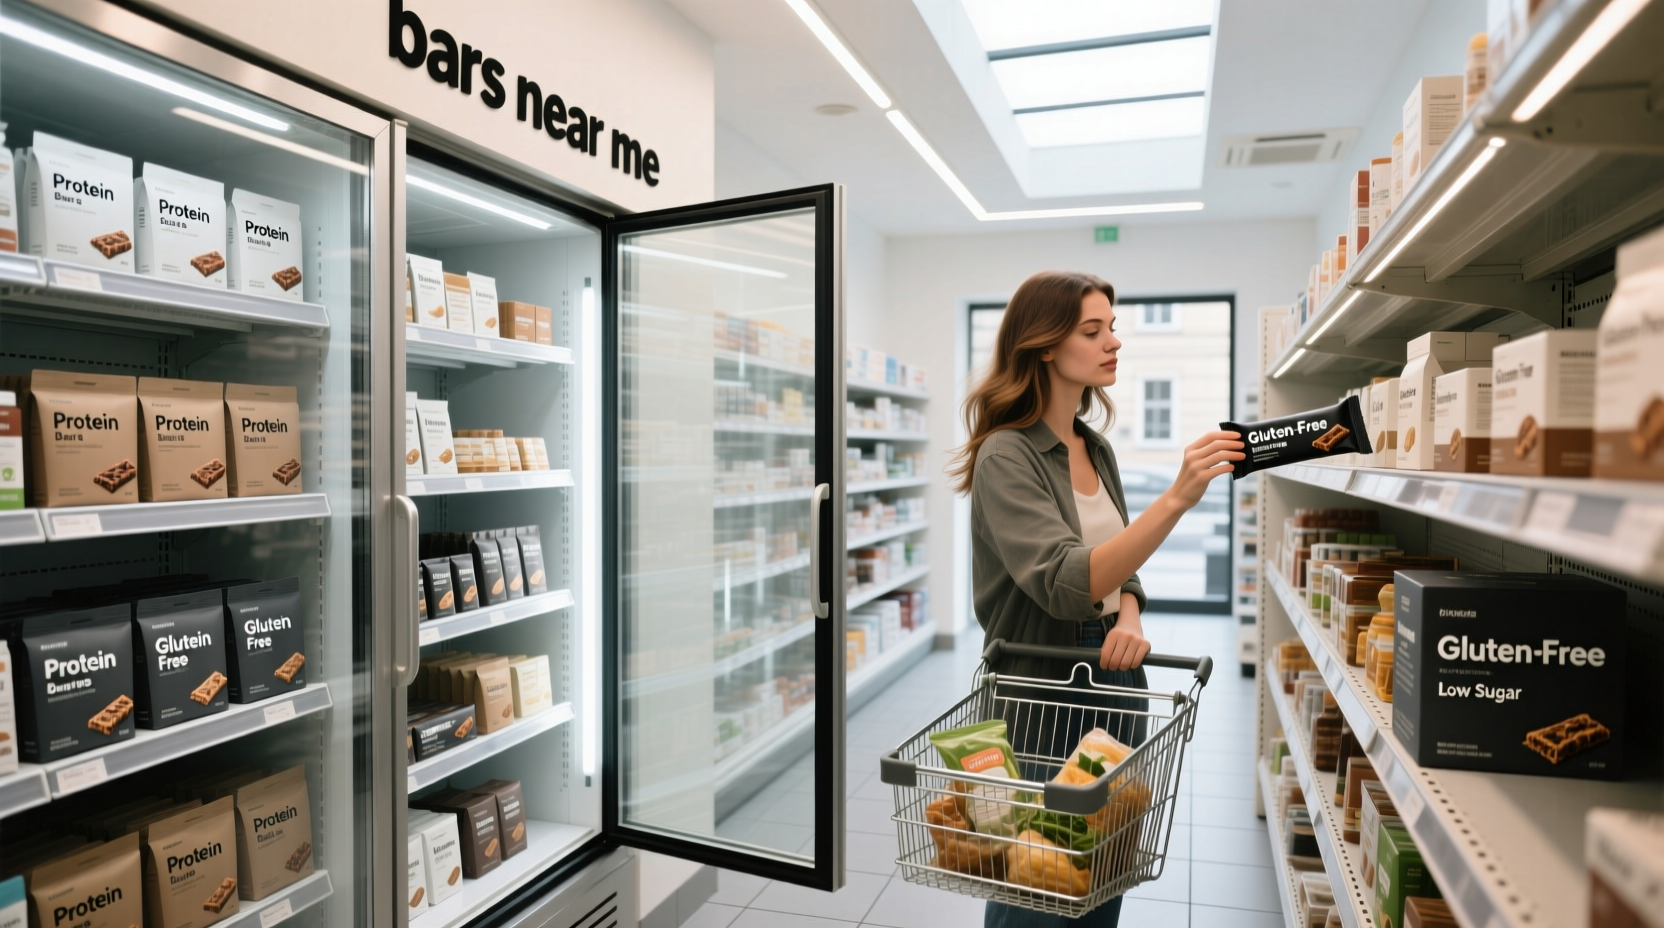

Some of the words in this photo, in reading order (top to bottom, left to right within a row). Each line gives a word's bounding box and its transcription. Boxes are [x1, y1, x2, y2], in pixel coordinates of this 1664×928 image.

[388, 0, 506, 109] bars
[517, 75, 604, 157] near
[611, 128, 660, 187] me
[53, 172, 114, 202] Protein
[159, 199, 210, 224] Protein
[245, 220, 289, 243] Protein
[54, 411, 119, 431] Protein
[155, 414, 209, 432] Protein
[241, 417, 288, 433] Protein
[1248, 419, 1328, 445] Gluten-Free
[155, 630, 212, 655] Glutein
[246, 635, 272, 650] Free
[1437, 635, 1606, 668] Gluten-Free
[44, 650, 117, 680] Protein
[158, 654, 189, 671] Free
[1438, 681, 1471, 698] Low
[1475, 683, 1522, 703] Sugar
[253, 805, 298, 833] Protein
[167, 841, 222, 874] Protein
[54, 886, 123, 927] Protein
